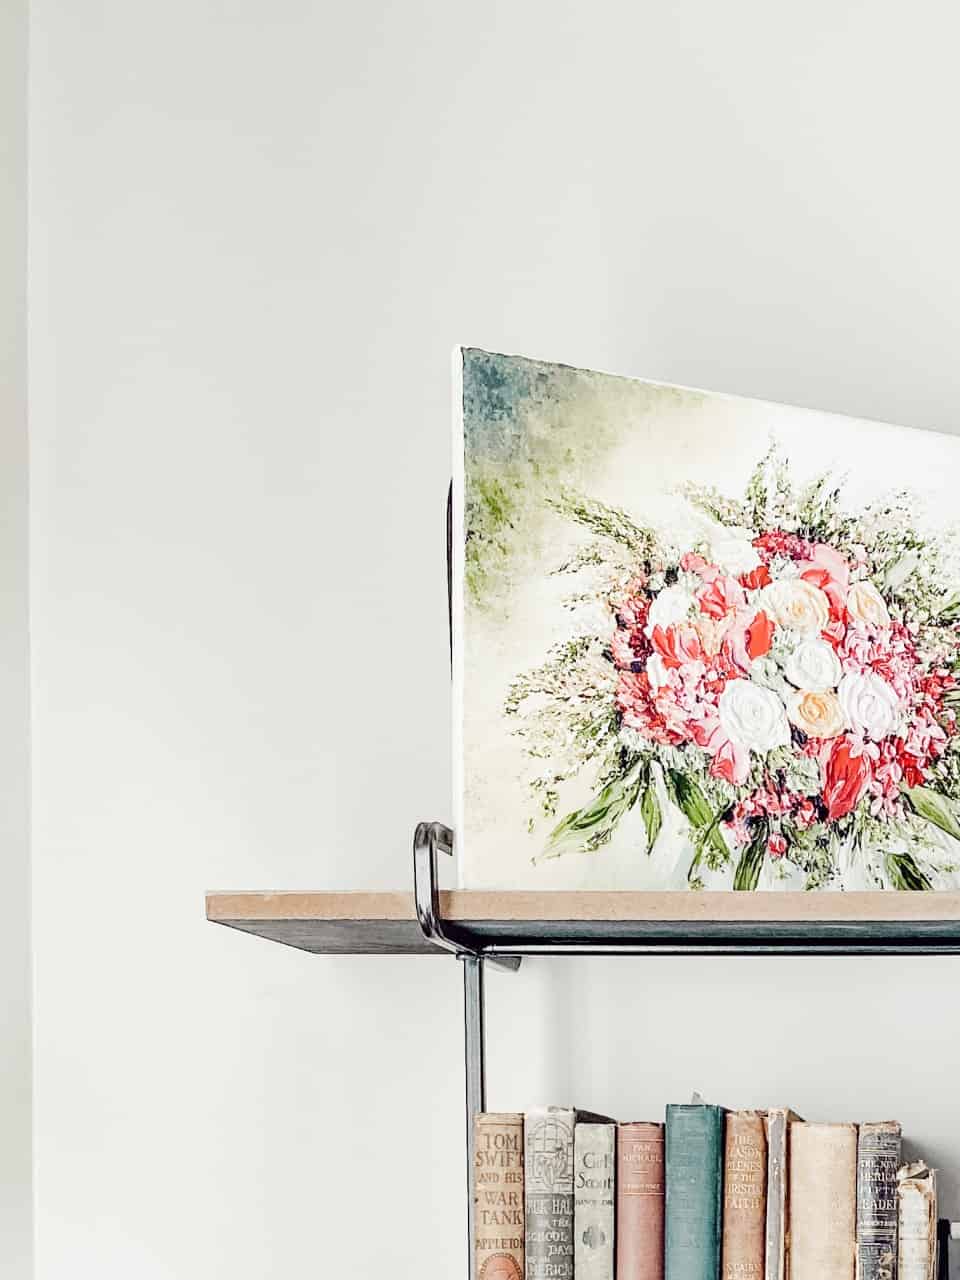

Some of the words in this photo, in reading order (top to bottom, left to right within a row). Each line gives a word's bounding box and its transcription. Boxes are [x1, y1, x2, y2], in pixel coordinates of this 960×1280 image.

[482, 1132, 519, 1150] TOM
[475, 1151, 523, 1167] SWIFT
[479, 1172, 499, 1183] AND
[484, 1191, 518, 1205] WAR
[551, 1199, 572, 1215] HAL
[480, 1210, 522, 1224] TANK
